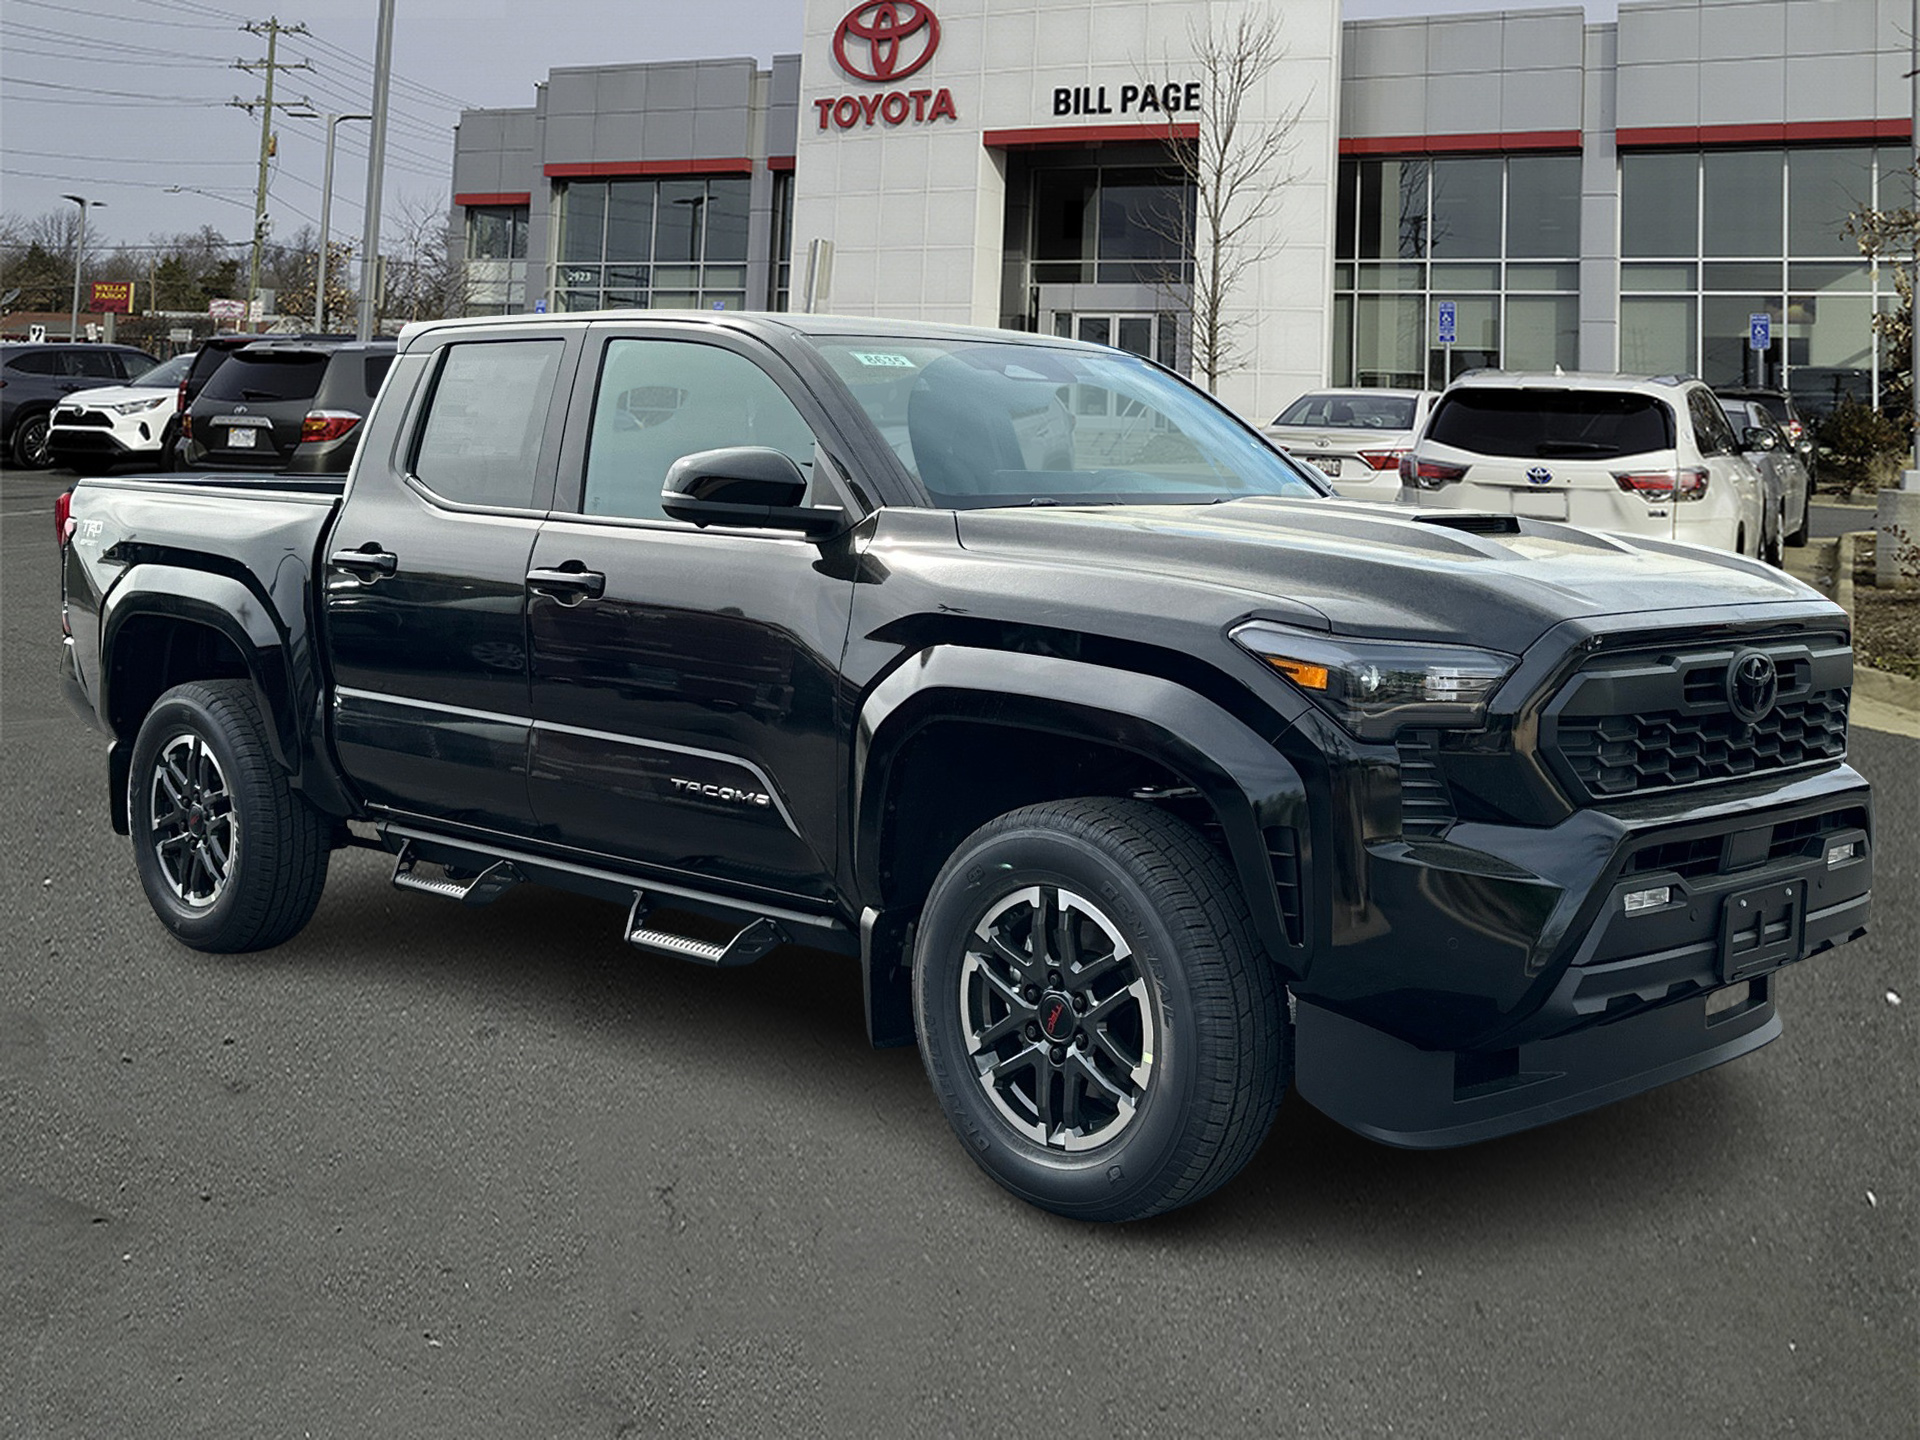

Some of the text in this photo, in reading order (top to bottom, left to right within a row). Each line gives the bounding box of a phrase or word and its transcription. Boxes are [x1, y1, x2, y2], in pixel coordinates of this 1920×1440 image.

[813, 88, 957, 130] TOYOTA
[1053, 82, 1201, 116] BILL PAGE
[94, 291, 127, 300] FARGO
[82, 519, 104, 538] TRD
[670, 777, 771, 809] TACOMA
[1045, 1003, 1064, 1035] TRD
